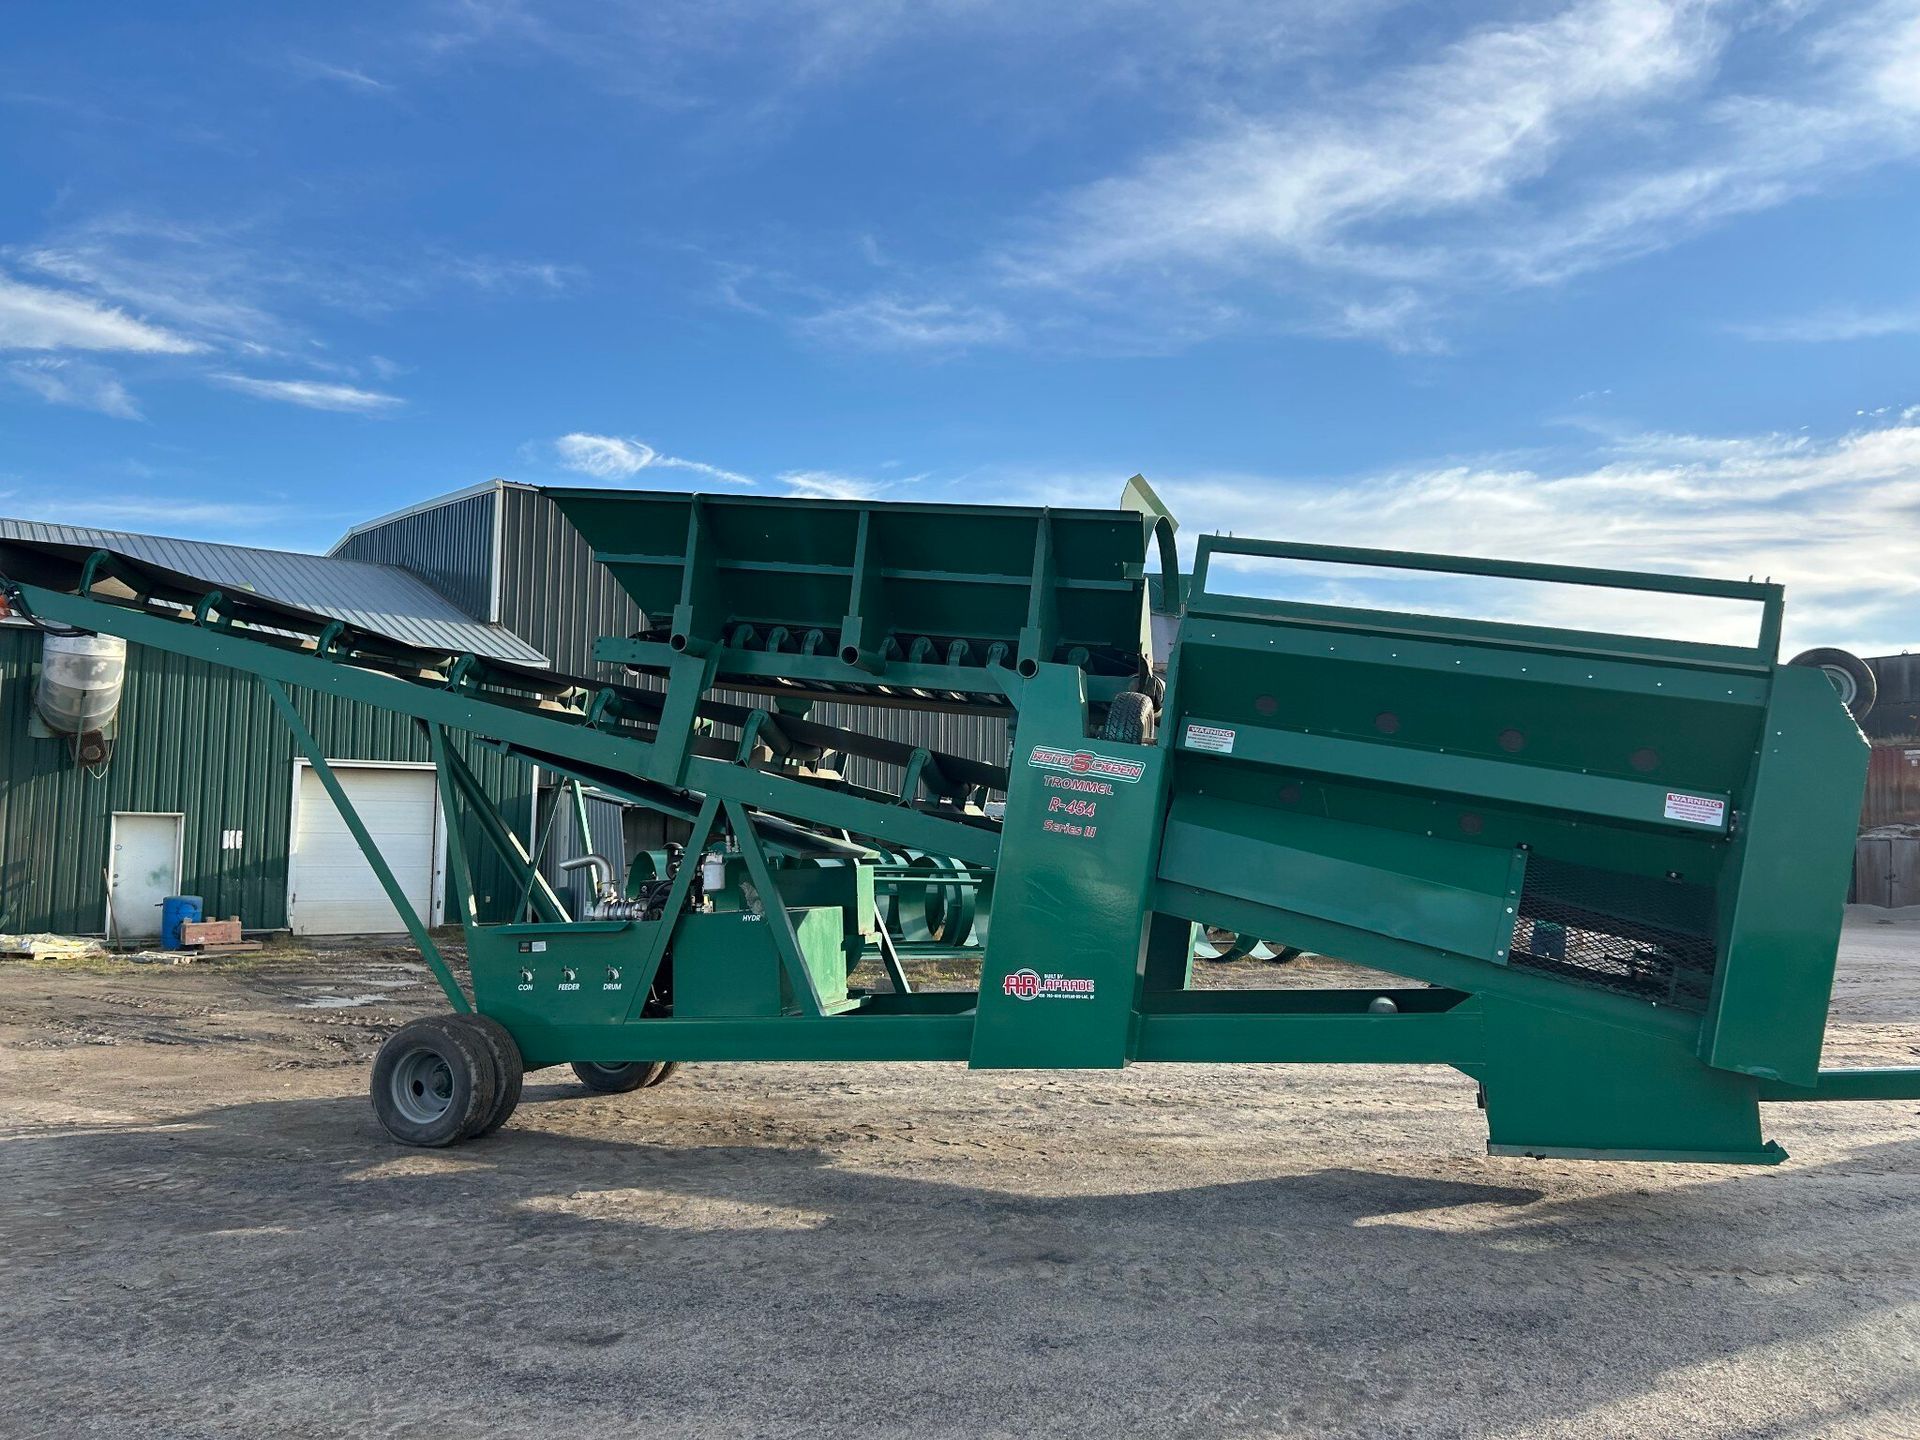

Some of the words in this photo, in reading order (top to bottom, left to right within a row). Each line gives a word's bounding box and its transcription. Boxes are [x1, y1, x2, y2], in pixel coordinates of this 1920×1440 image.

[1190, 726, 1233, 737] WARNING
[1043, 775, 1115, 796] TROMMEL
[1048, 796, 1096, 817] R-454
[1670, 795, 1722, 808] WARNING
[1043, 819, 1082, 836] Series
[742, 914, 761, 922] HYDR
[517, 983, 533, 991] CON
[558, 983, 580, 991] FEEDER
[603, 983, 622, 991] DRUM
[1038, 979, 1095, 992] LAPRADE
